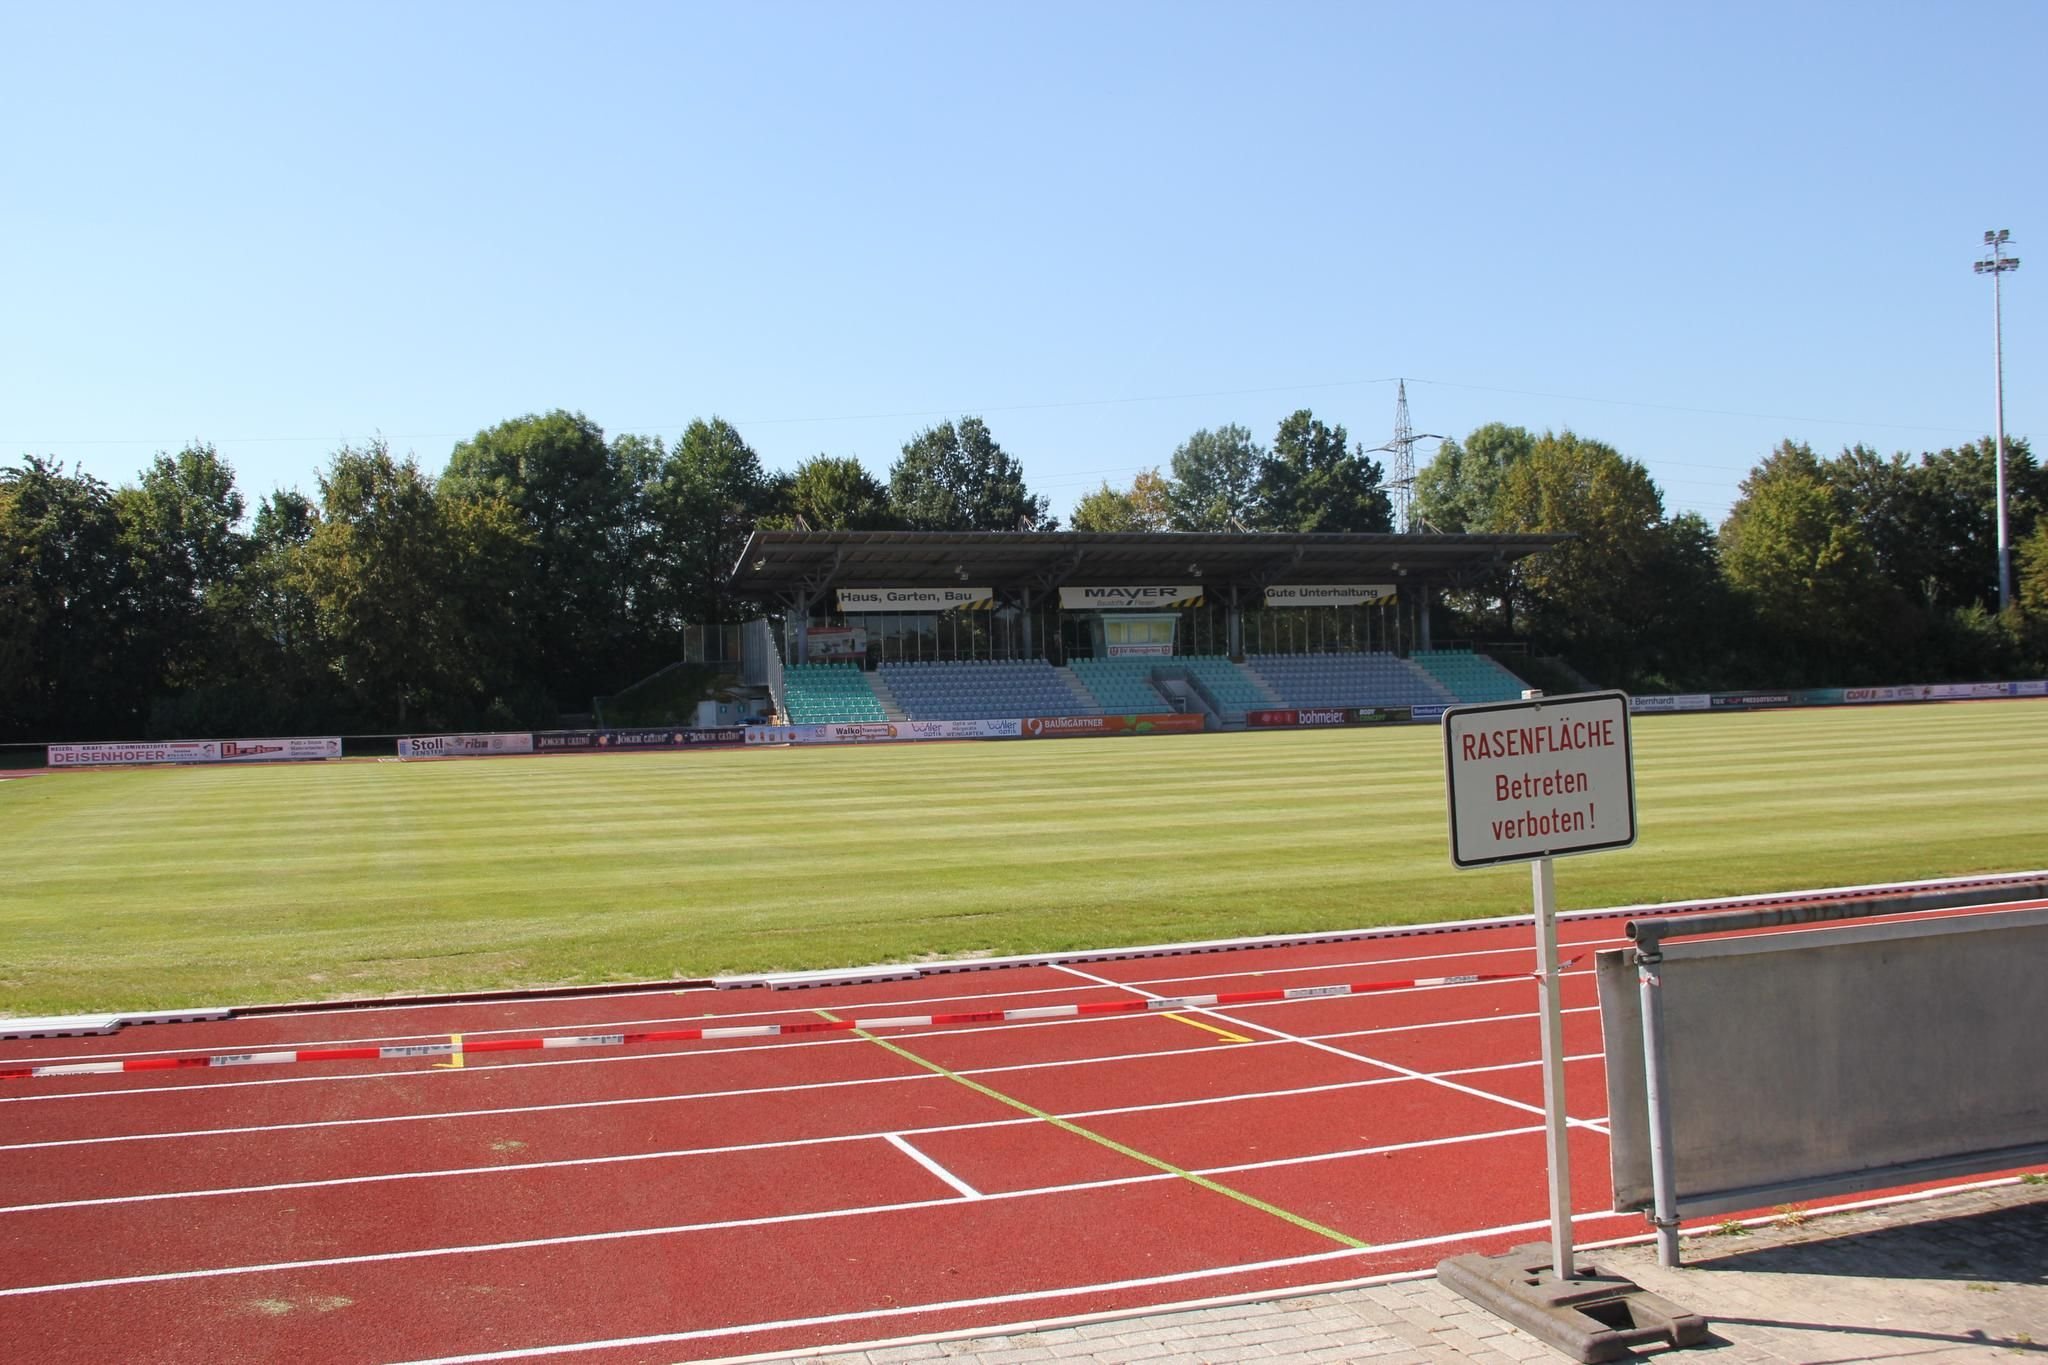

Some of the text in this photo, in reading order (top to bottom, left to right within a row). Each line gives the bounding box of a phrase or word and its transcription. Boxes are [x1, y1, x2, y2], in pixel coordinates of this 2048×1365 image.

[841, 591, 972, 603] Haus, Garten, Bau
[1085, 588, 1177, 604] MAYER
[1266, 588, 1378, 599] Gute Unterhaltung
[835, 726, 860, 735] Walko
[411, 738, 443, 751] Stoll
[615, 733, 641, 744] JOKER
[1462, 717, 1615, 761] RASENFLÄCHE
[54, 750, 165, 763] DEISENHOFER
[1495, 769, 1588, 801] Betreten
